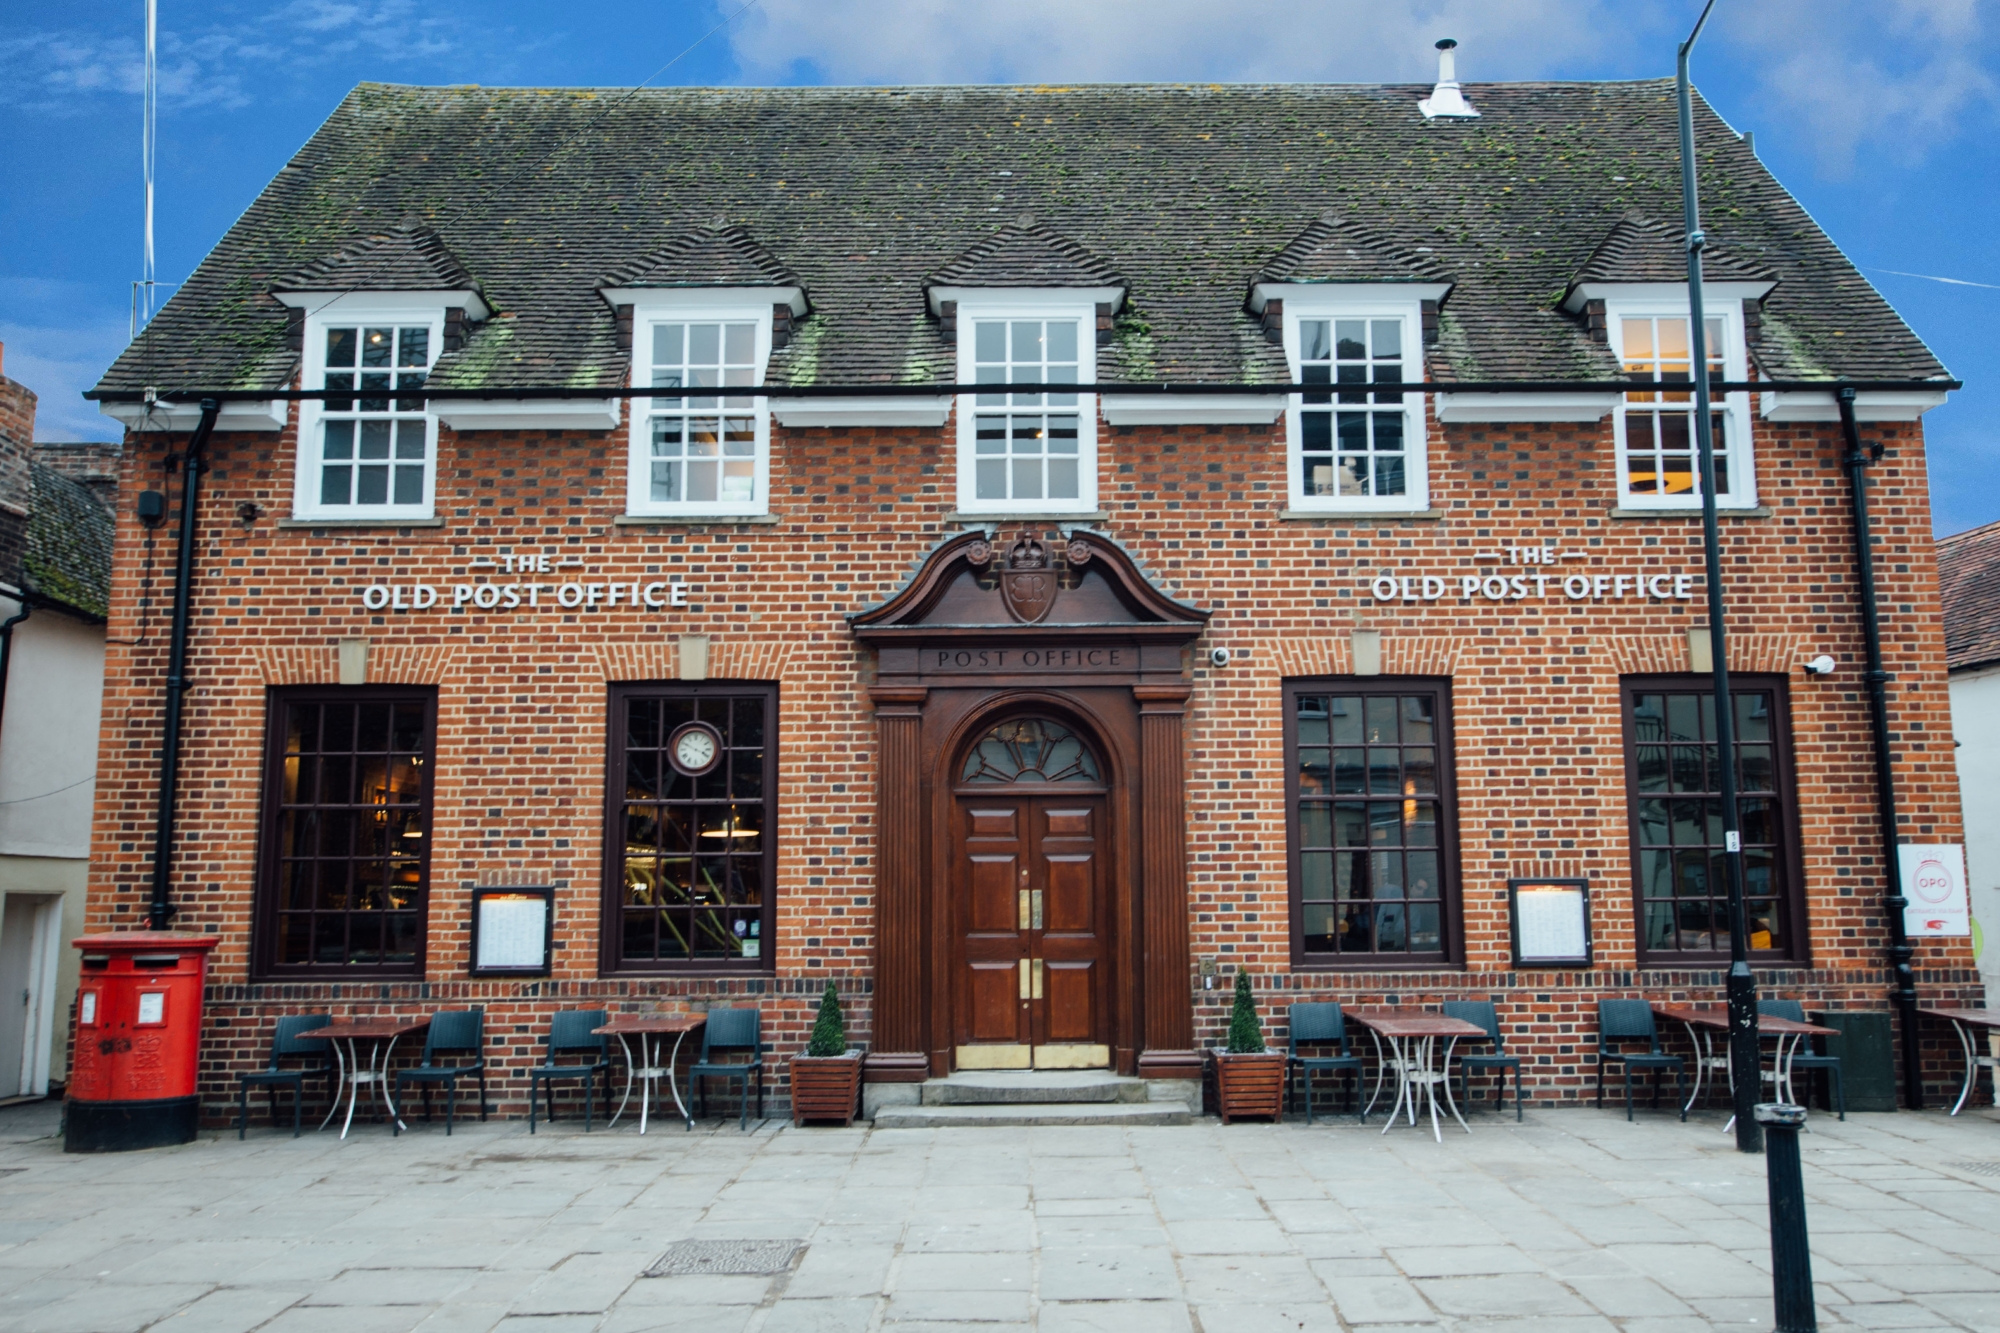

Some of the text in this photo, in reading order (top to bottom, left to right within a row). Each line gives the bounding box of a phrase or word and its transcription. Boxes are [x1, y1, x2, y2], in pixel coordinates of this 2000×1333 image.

[502, 555, 550, 573] THE
[1506, 547, 1554, 565] THE
[362, 581, 690, 610] OLD POST OFFICE
[1371, 573, 1694, 601] OLD POST OFFICE
[938, 651, 1120, 667] POST OFFICE
[1919, 878, 1947, 888] OPO
